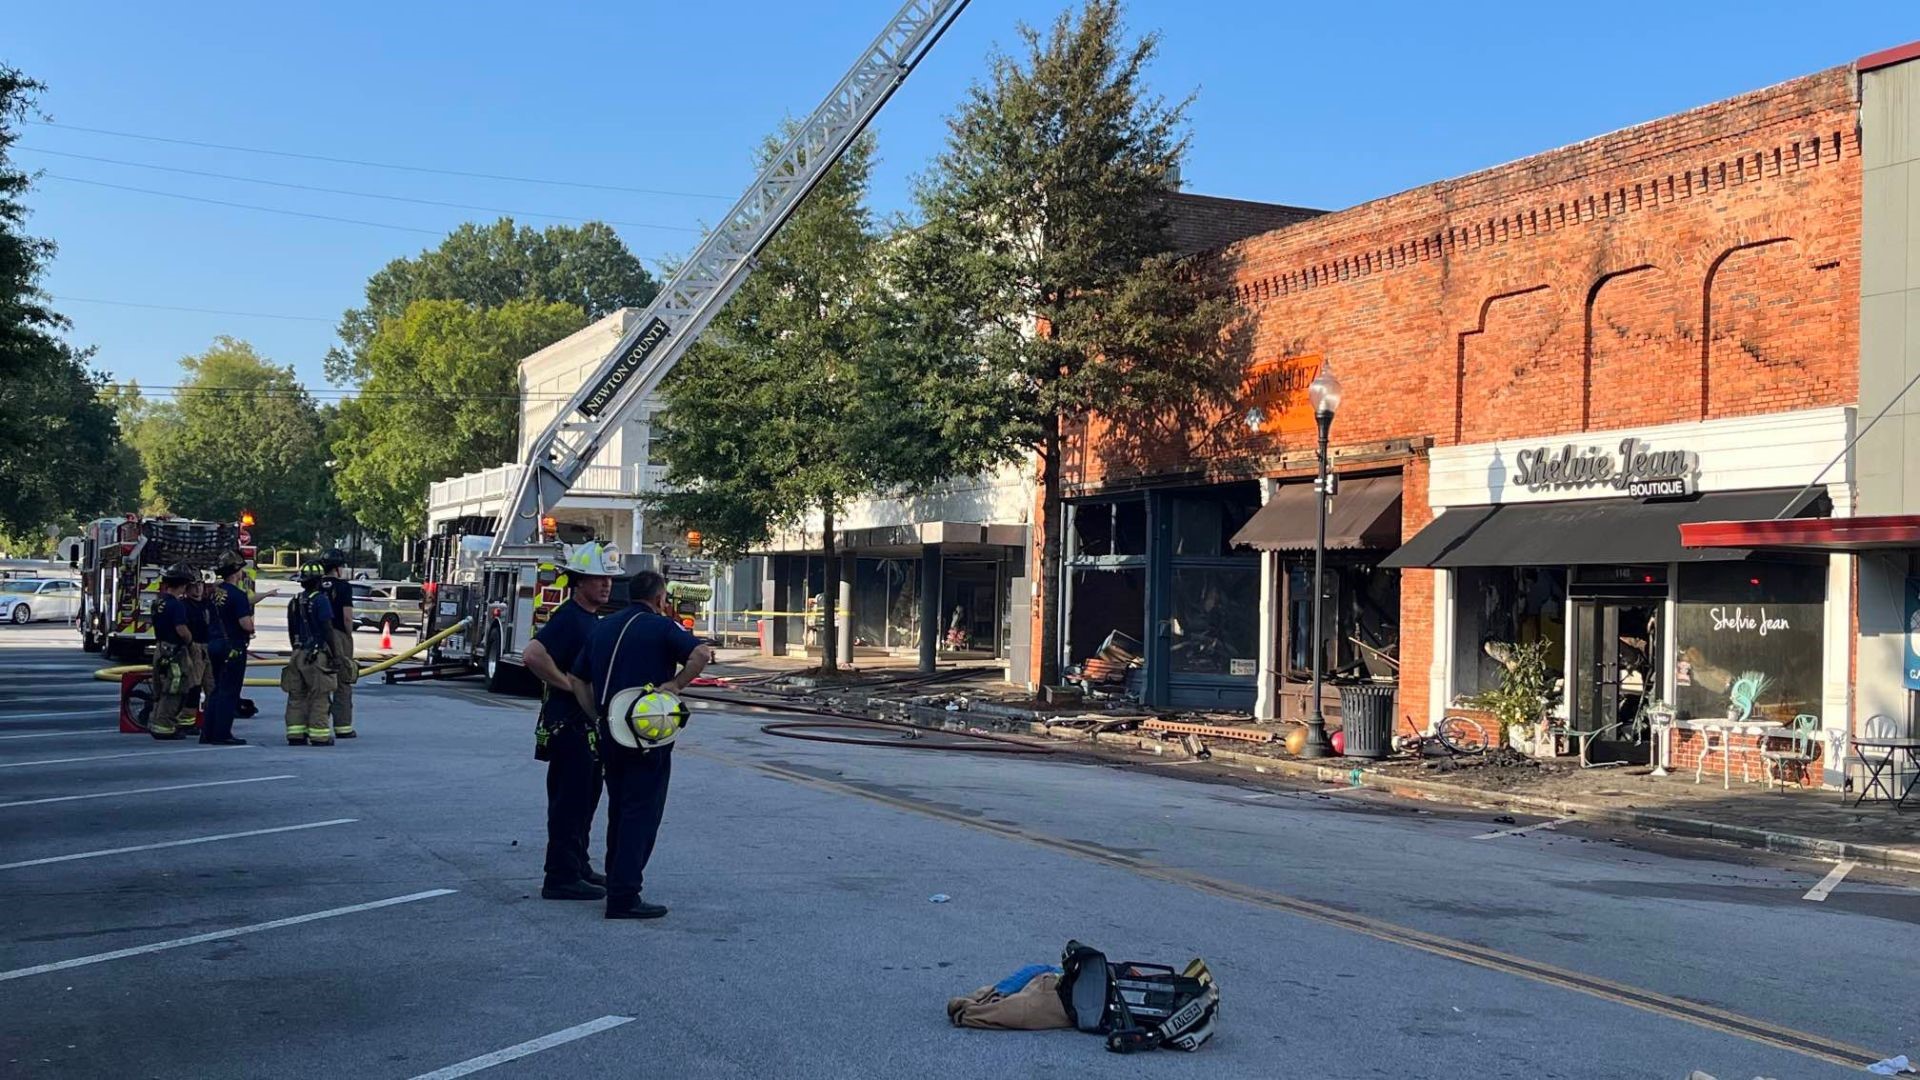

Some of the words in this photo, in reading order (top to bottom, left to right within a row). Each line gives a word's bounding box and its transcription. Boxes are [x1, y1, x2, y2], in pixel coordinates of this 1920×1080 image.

[587, 363, 630, 412] NEWTON
[627, 320, 666, 366] COUNTY
[1513, 443, 1610, 486] Shelvie
[1615, 438, 1689, 489] Jean
[1630, 481, 1683, 497] BOUTIQUE
[1710, 606, 1757, 633] Shelvie
[1759, 607, 1790, 637] Jean
[1174, 1005, 1201, 1028] MSA
